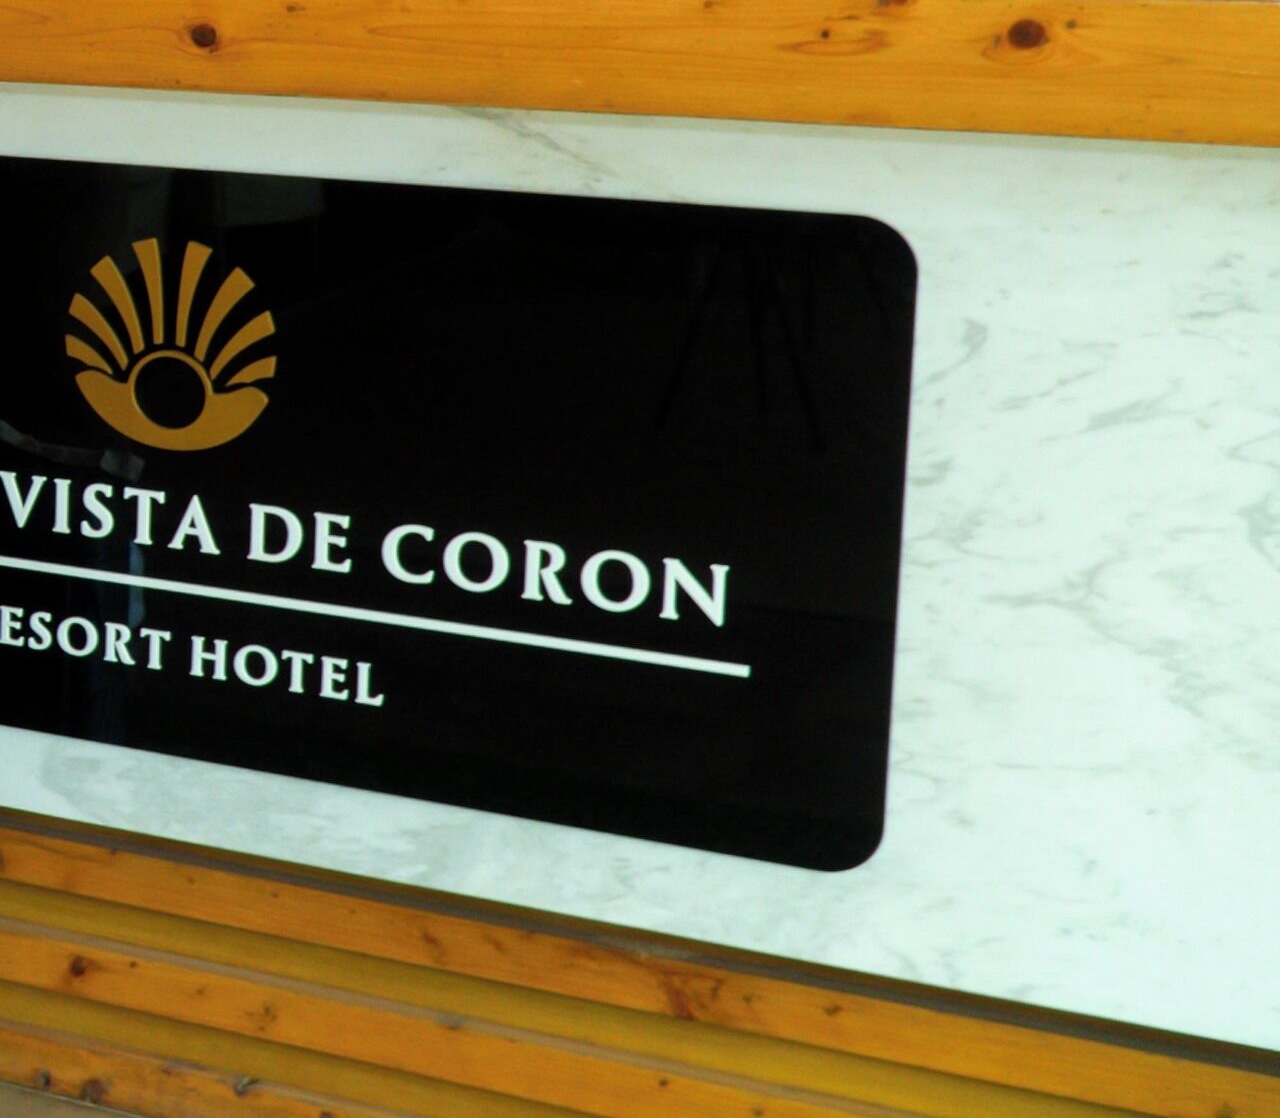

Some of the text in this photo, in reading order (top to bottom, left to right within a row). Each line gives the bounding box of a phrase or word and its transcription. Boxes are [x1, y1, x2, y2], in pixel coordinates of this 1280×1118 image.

[246, 503, 352, 574] DE
[381, 524, 730, 627] CORON
[189, 635, 384, 707] HOTEL
